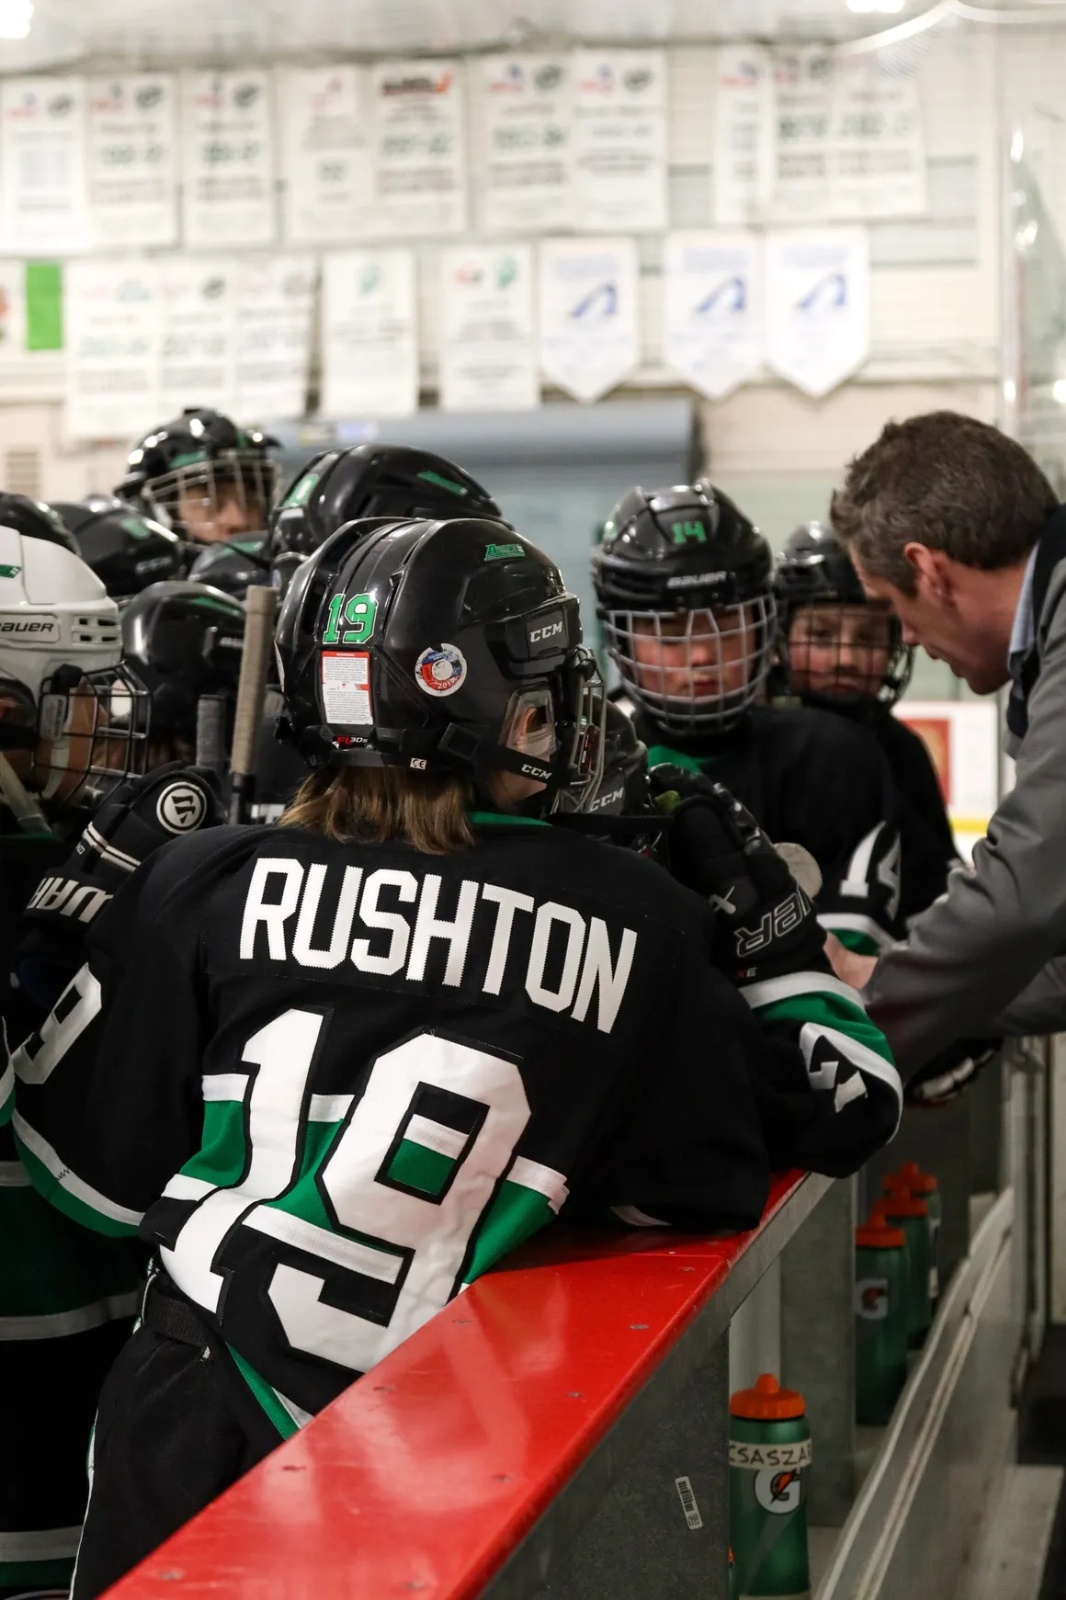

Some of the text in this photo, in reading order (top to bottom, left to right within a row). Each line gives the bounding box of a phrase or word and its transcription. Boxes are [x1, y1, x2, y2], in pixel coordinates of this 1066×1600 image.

[672, 521, 707, 545] 14
[0, 622, 54, 632] AUER
[323, 593, 379, 645] 19
[530, 621, 563, 643] CCM
[521, 763, 552, 780] CCM
[589, 787, 624, 812] CCM
[239, 857, 638, 1034] RUSHTON
[159, 1008, 532, 1375] 19
